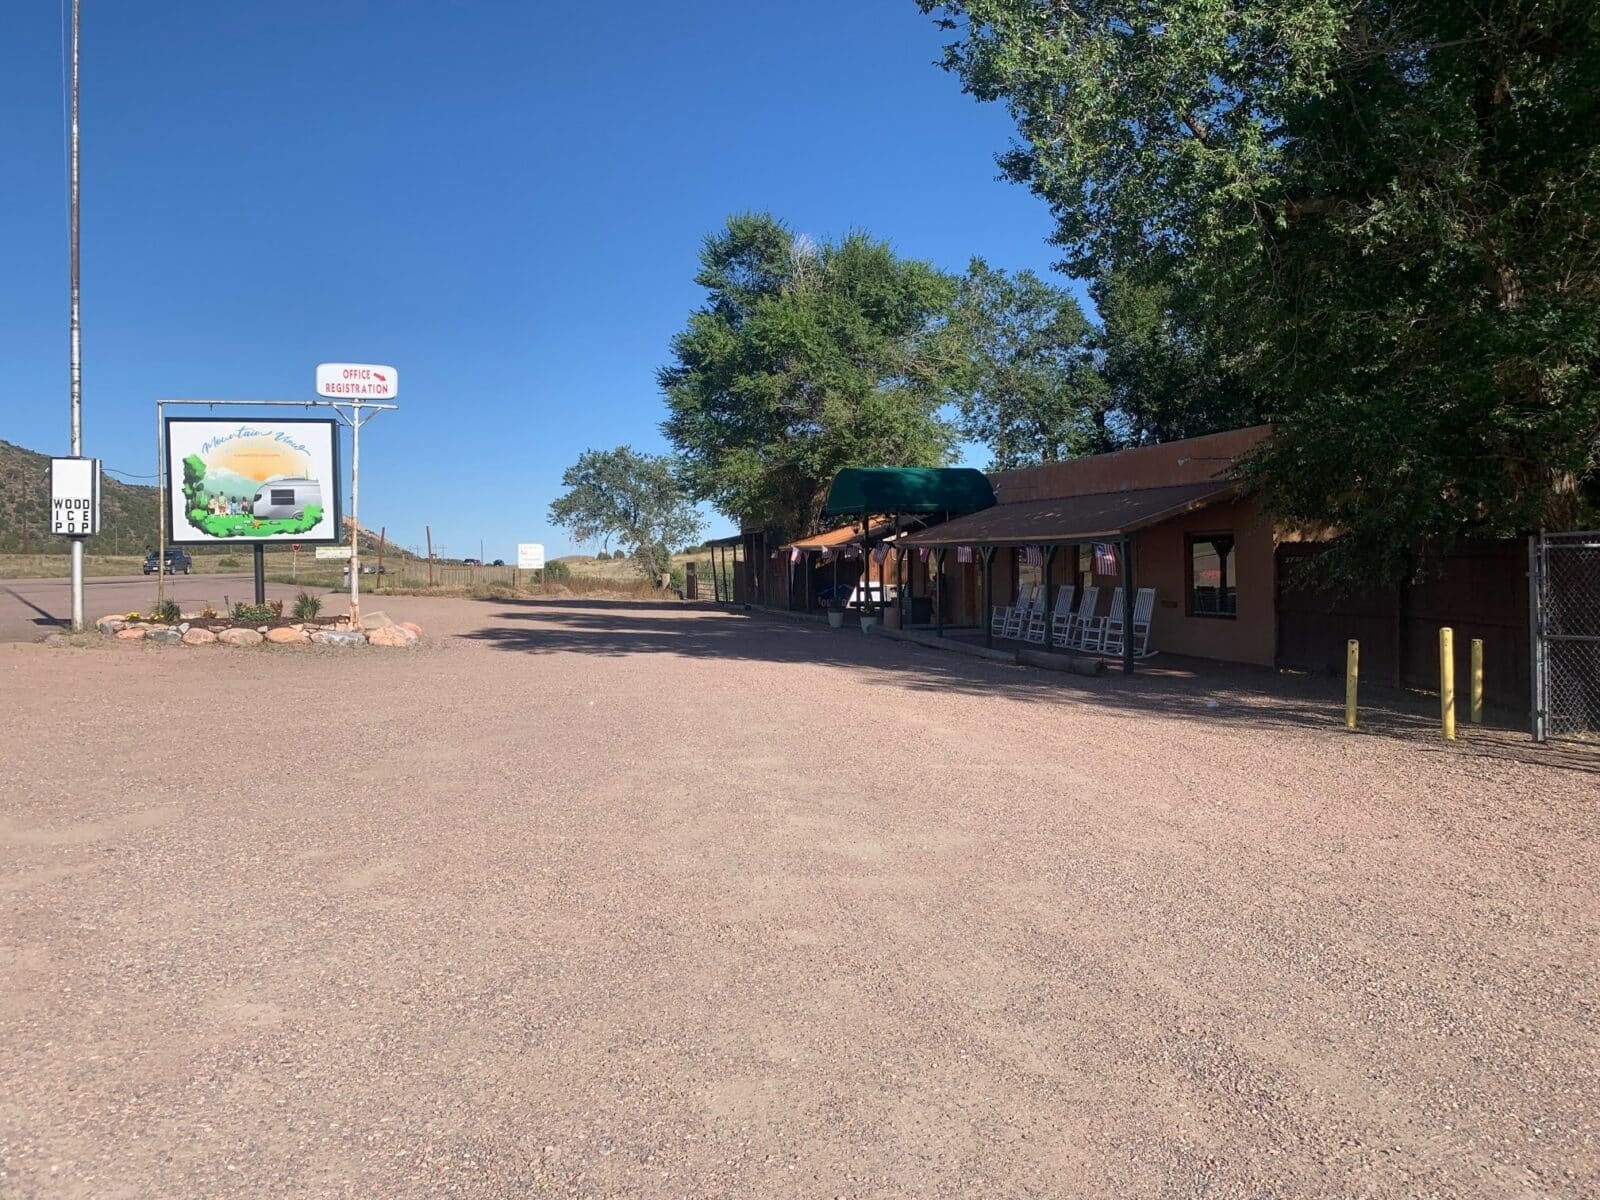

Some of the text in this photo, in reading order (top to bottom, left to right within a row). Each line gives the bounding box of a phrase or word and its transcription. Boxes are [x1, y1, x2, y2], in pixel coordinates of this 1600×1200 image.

[343, 369, 370, 379] OFFICE
[325, 383, 389, 394] REGISTRATION
[201, 425, 272, 454] Mountain
[54, 498, 90, 510] WOOD
[56, 510, 89, 521] ICE
[55, 522, 89, 533] POP
